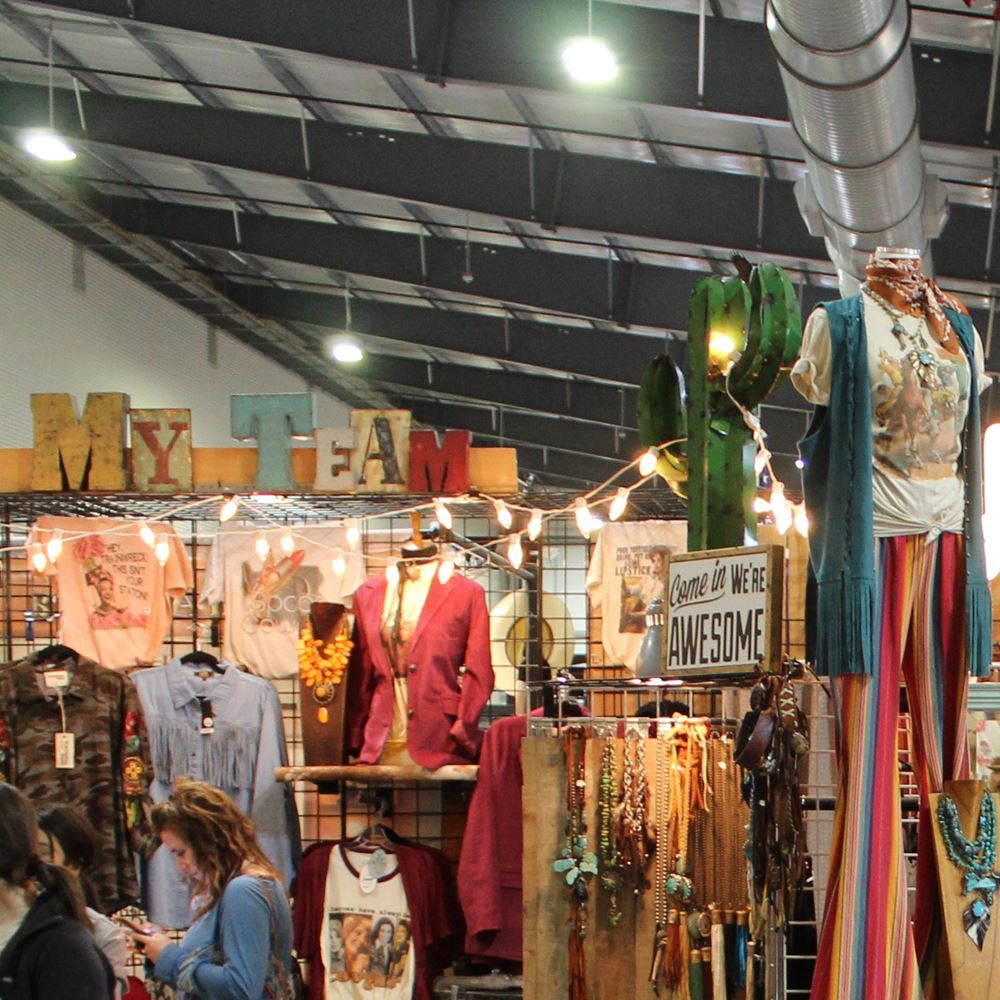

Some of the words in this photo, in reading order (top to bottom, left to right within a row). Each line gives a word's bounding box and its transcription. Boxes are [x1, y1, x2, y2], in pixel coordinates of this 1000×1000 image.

[31, 393, 191, 491] MY
[231, 393, 472, 491] TEAM
[670, 572, 709, 607] Come
[711, 559, 726, 592] in
[731, 562, 766, 594] WE'RE
[668, 608, 765, 666] AWESOME
